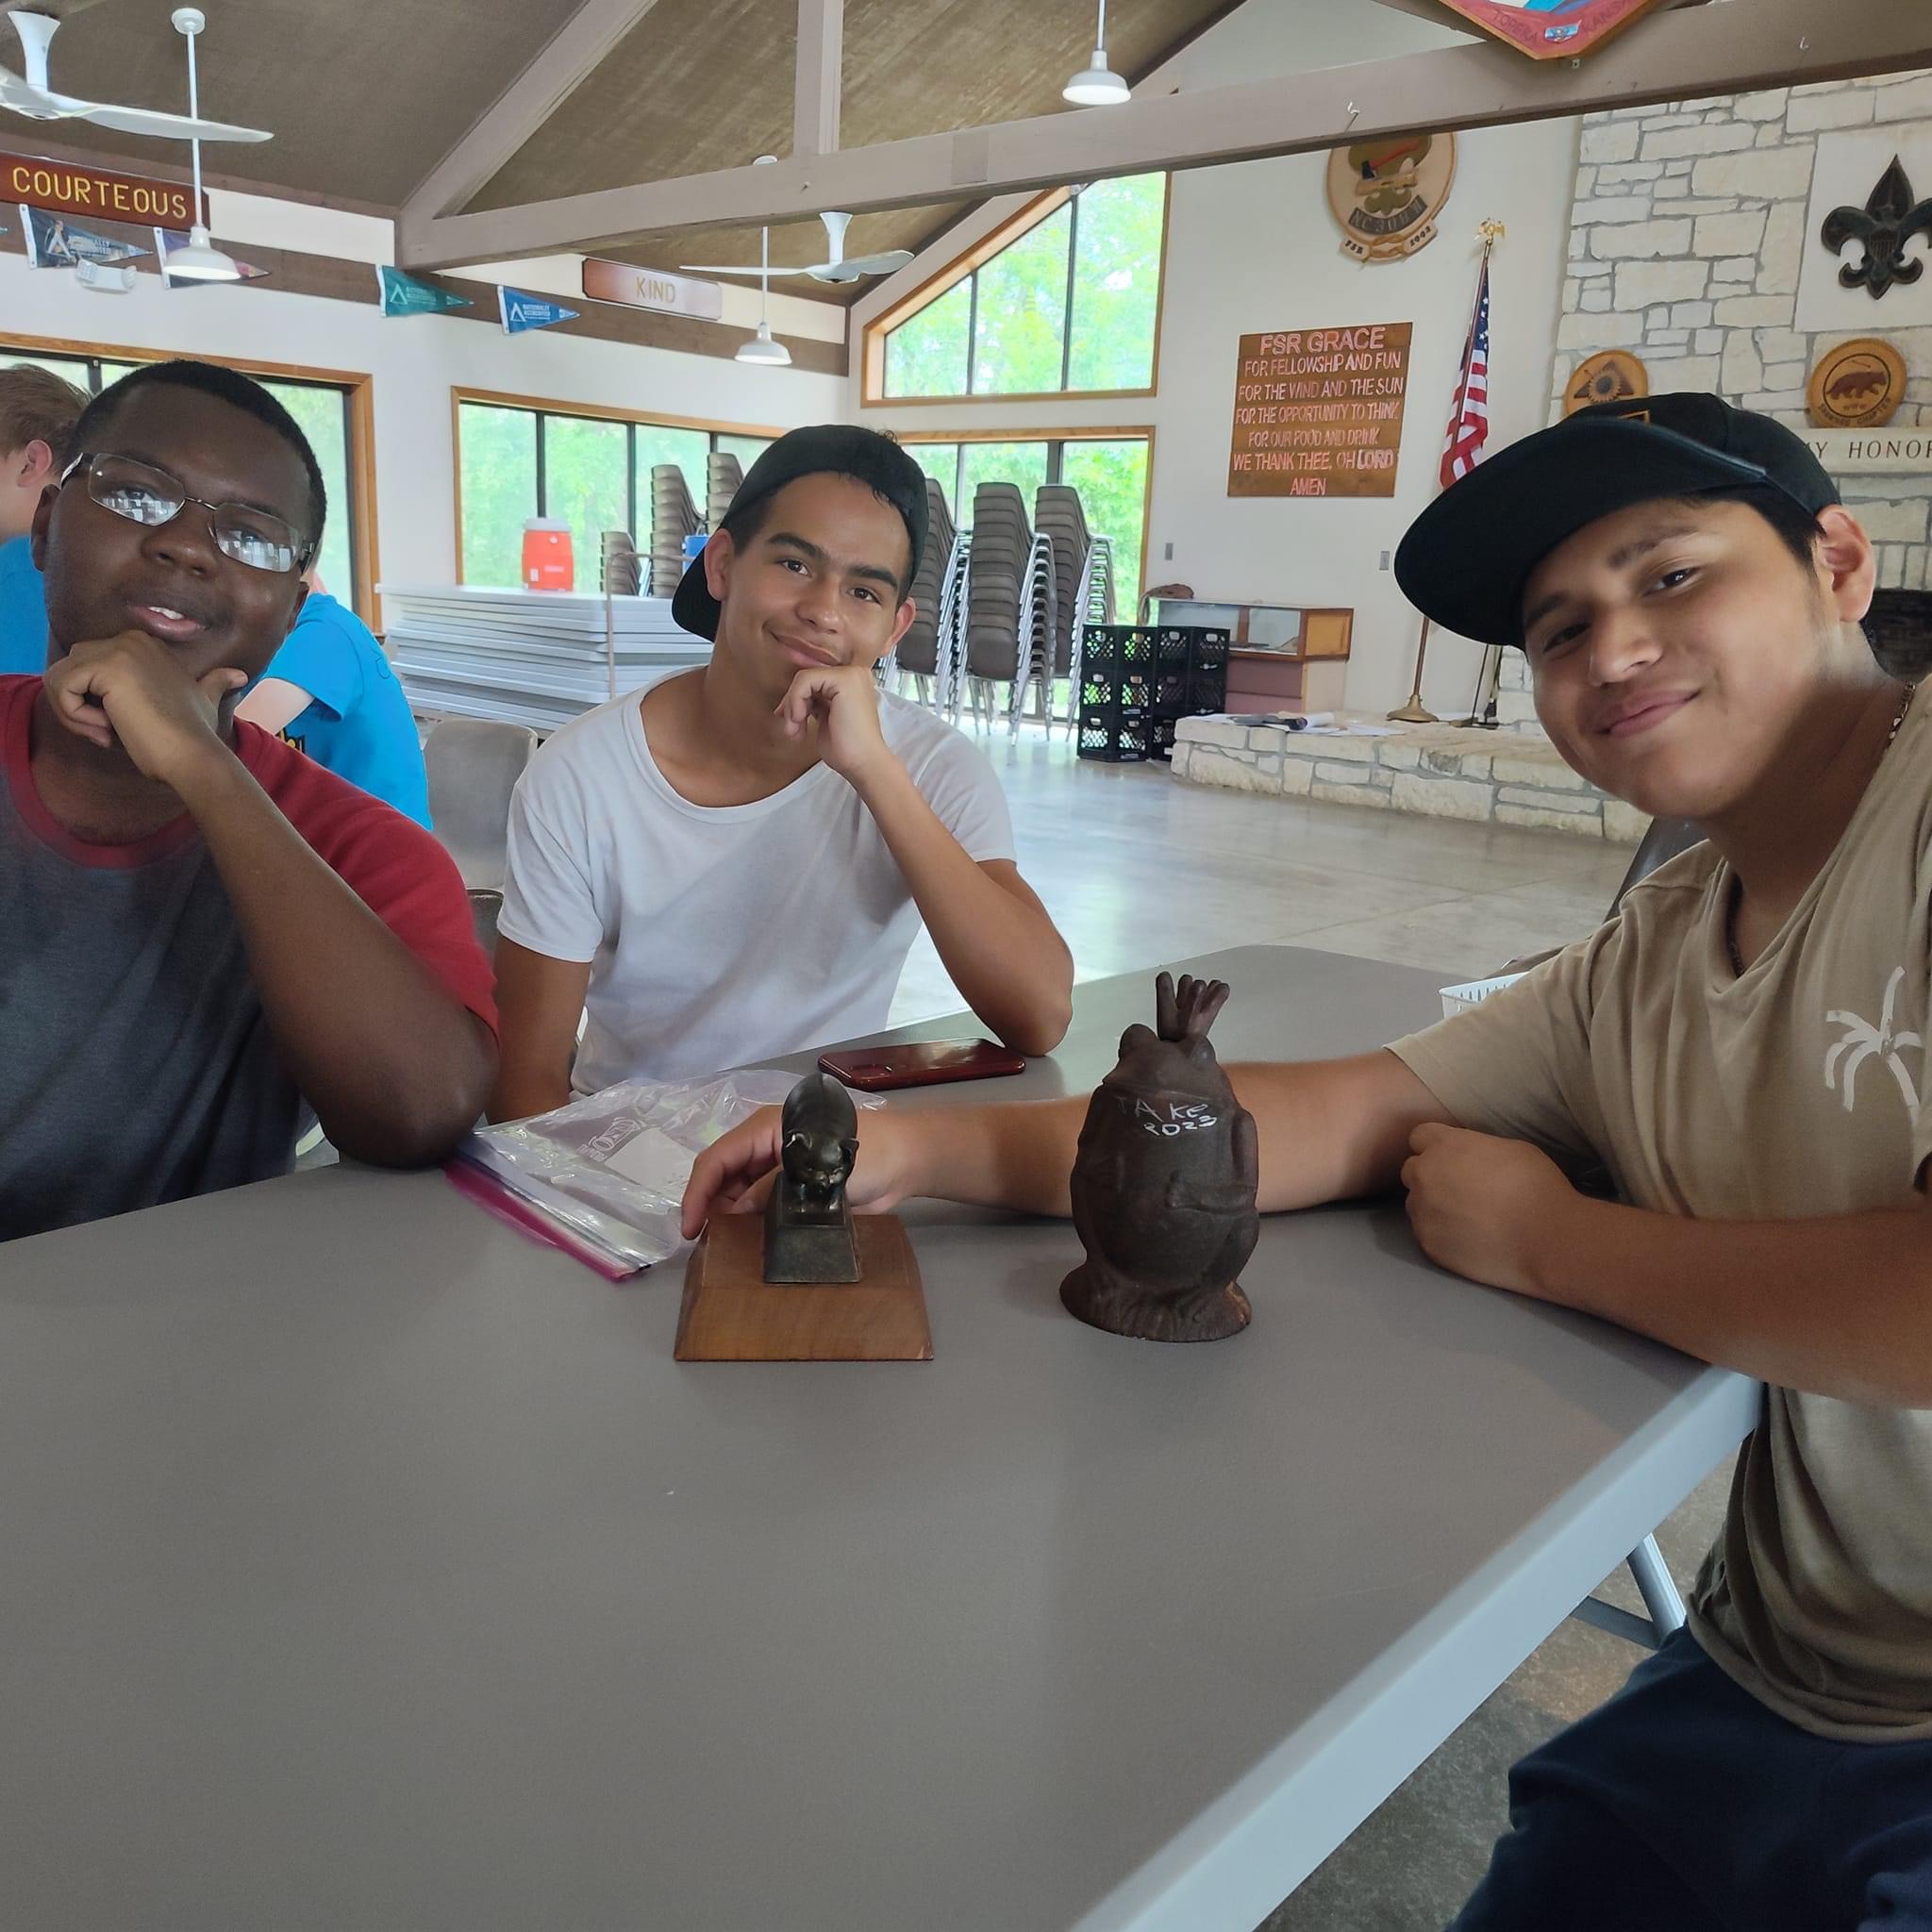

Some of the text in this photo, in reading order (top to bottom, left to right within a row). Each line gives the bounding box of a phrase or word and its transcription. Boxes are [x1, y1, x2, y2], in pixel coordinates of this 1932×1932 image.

[12, 166, 187, 219] COURTEOUS
[1344, 240, 1364, 255] FSR
[634, 275, 676, 304] KIND
[1260, 326, 1386, 356] FSR GRACE
[1244, 351, 1402, 377] FOR FELLOWSHIP AND FUN
[1238, 376, 1405, 402] FOR THE WIND AND THE SUN
[1235, 401, 1400, 425] FOR THE OPPORTUNITY TO THINK
[1248, 426, 1380, 448] FOR OUR FOOD AND DRINK
[1233, 453, 1252, 471] WE
[1254, 452, 1295, 471] THANK
[1336, 450, 1356, 470] OH
[1357, 448, 1394, 470] LORD
[1290, 477, 1327, 496] AMEN
[1143, 1114, 1217, 1137] 2023
